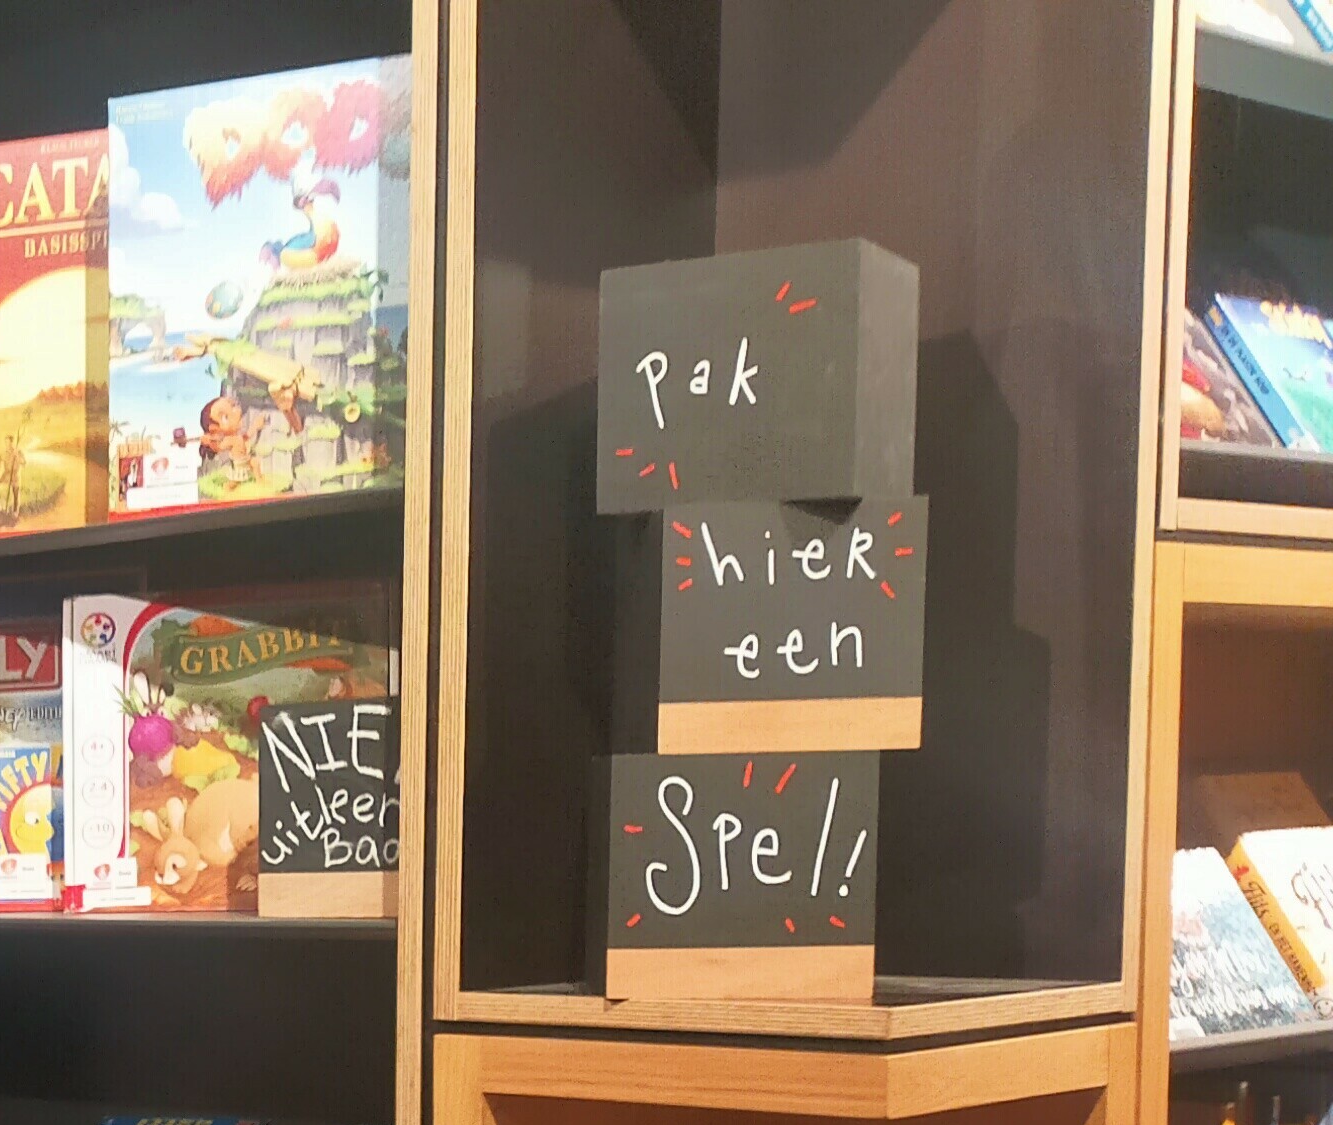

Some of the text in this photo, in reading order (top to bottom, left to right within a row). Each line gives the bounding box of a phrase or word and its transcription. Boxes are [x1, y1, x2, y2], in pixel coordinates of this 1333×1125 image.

[636, 336, 759, 430] pak
[723, 622, 865, 680] een
[261, 703, 399, 794] NIE
[645, 774, 867, 917] Spel!
